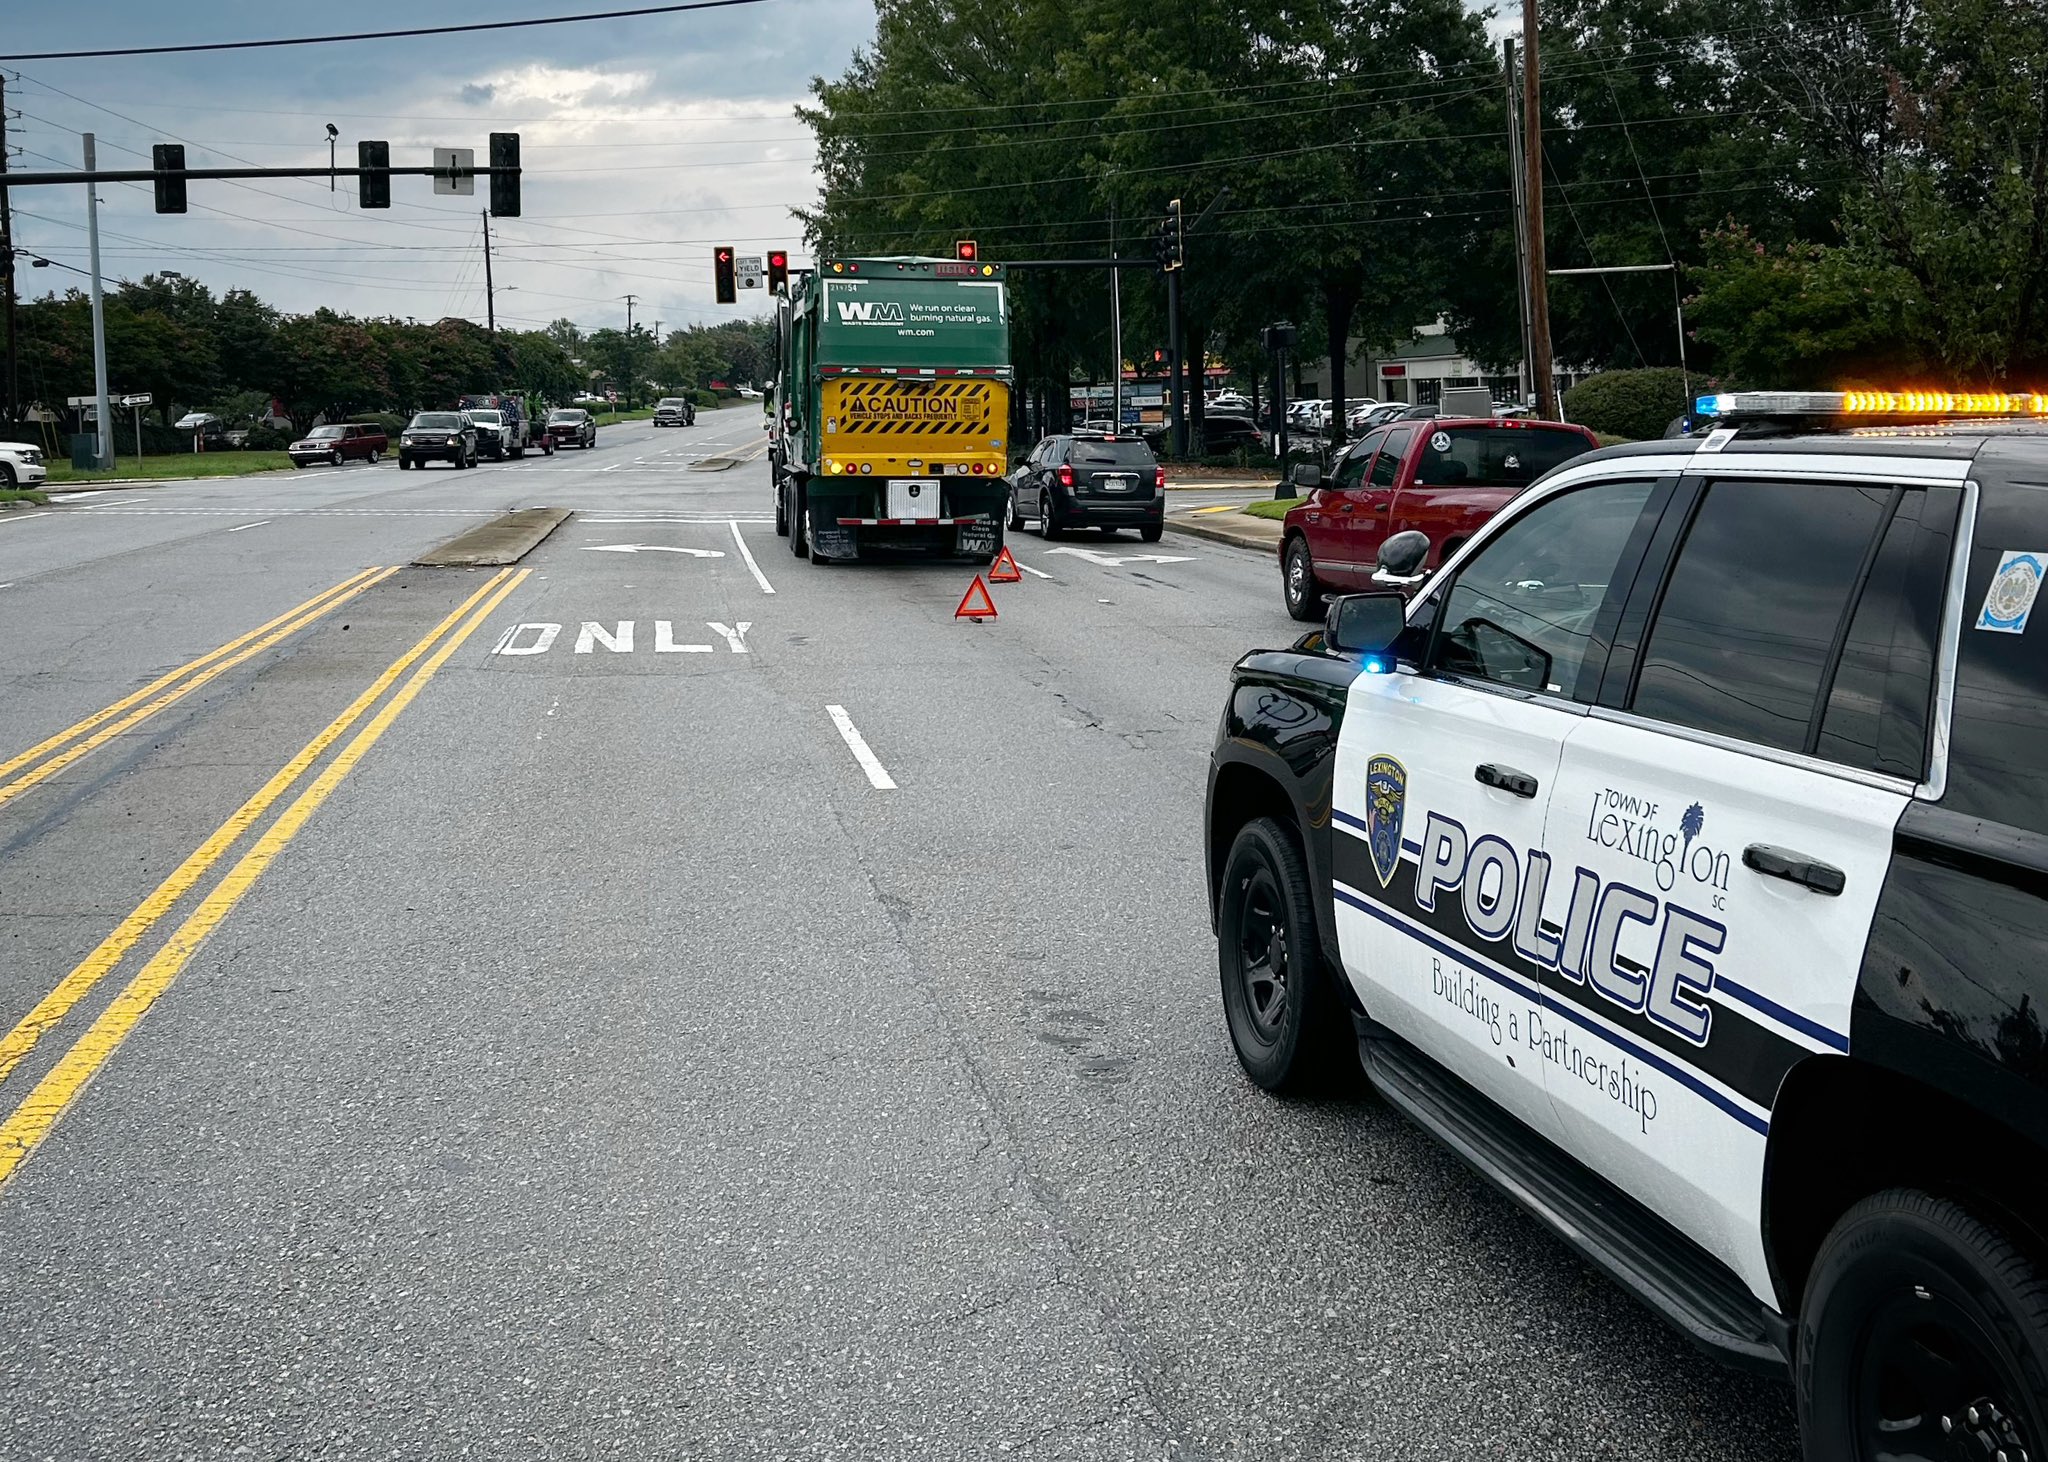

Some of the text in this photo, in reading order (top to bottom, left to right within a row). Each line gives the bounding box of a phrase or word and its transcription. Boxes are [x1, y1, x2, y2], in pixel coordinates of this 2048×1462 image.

[837, 302, 904, 320] WM
[909, 303, 923, 312] We
[954, 304, 976, 312] clean
[910, 313, 993, 324] burning natural gas.
[898, 328, 935, 337] wm.com
[868, 397, 957, 413] CAUTION
[849, 412, 872, 420] VEHICLE
[873, 412, 891, 420] STOPS
[923, 413, 957, 421] FREQUENTLY
[491, 620, 752, 655] ONLY
[1369, 764, 1405, 785] LEXINGTON
[1604, 788, 1641, 814] TOWN
[1587, 790, 1731, 892] Lexington
[1711, 894, 1726, 911] SC
[1415, 810, 1727, 1047] POLICE
[1432, 957, 1657, 1134] Building a Partnership
